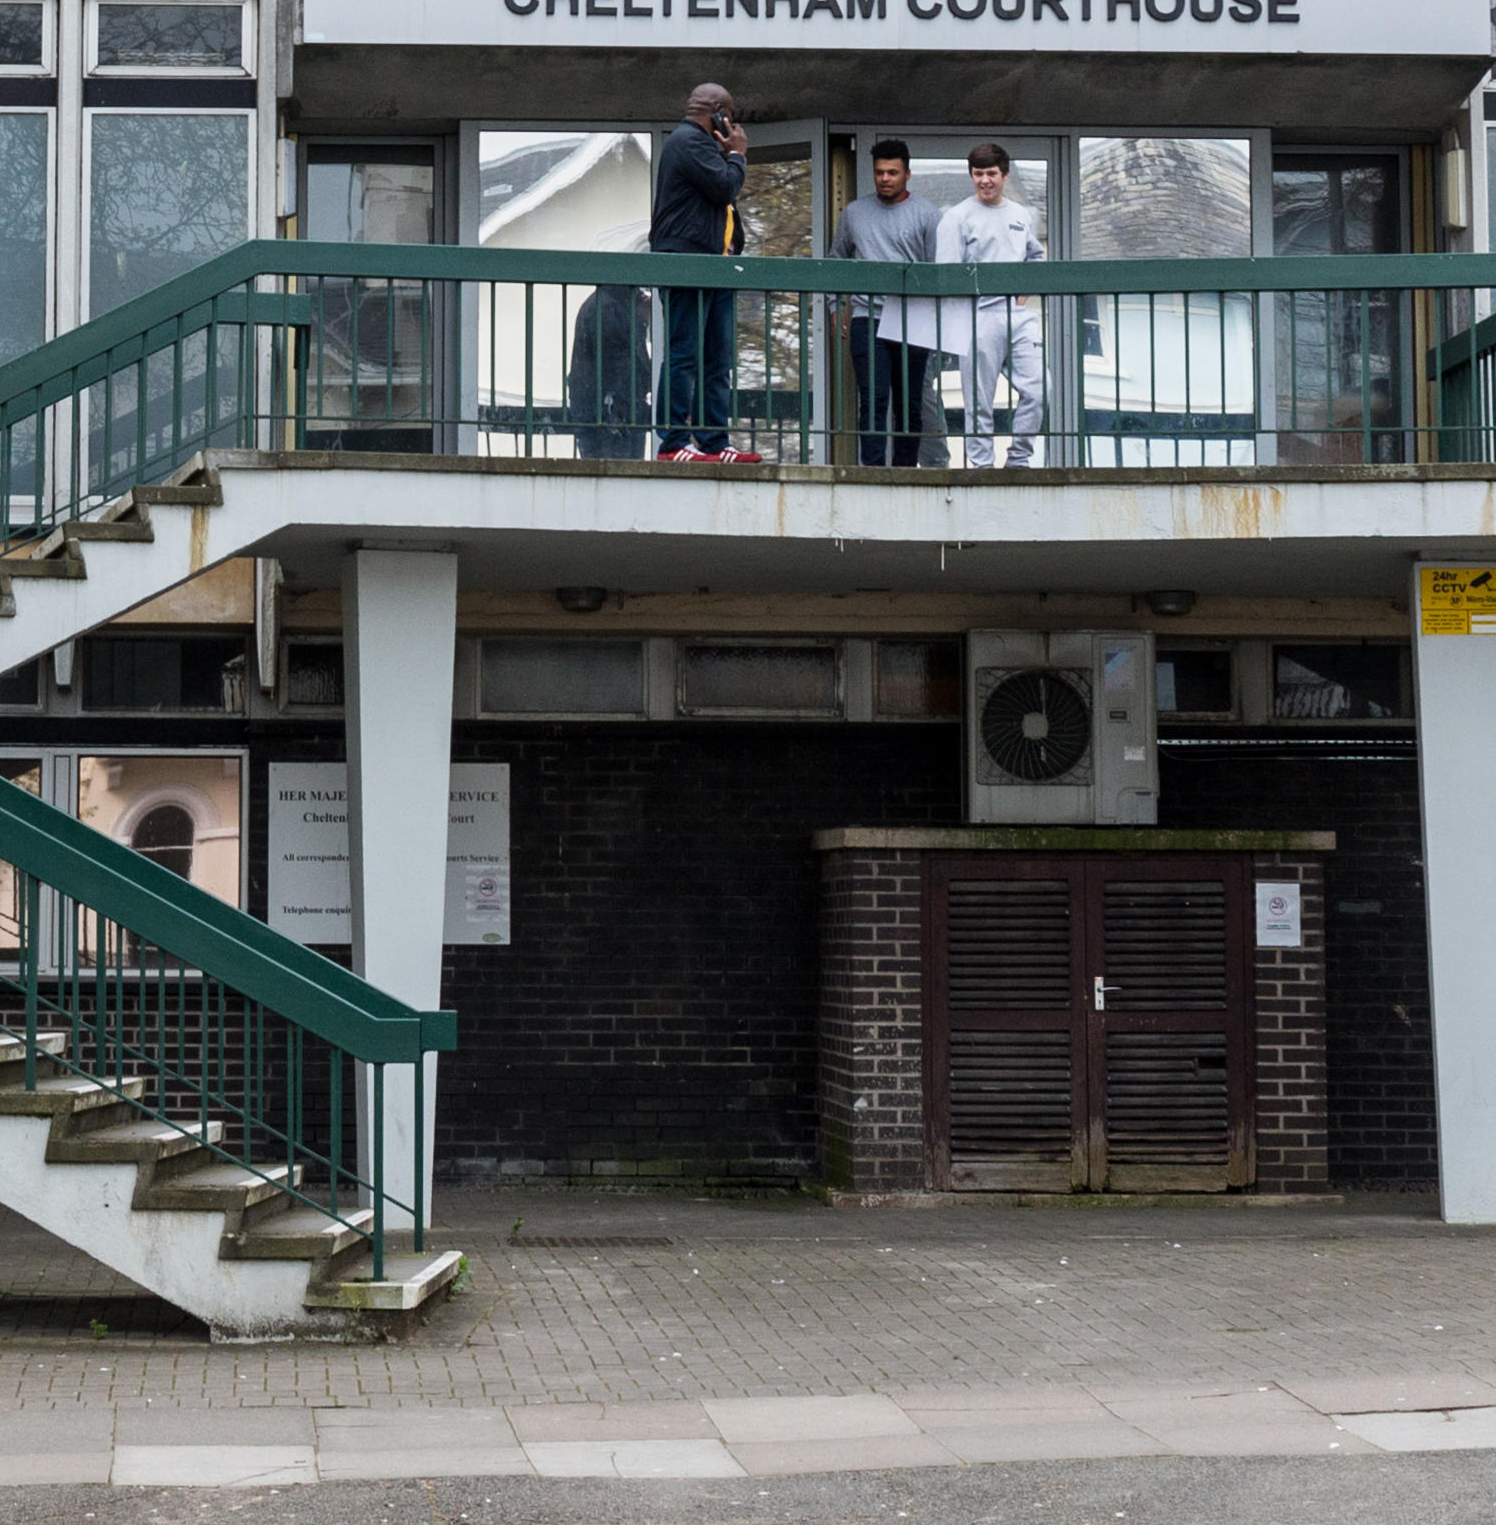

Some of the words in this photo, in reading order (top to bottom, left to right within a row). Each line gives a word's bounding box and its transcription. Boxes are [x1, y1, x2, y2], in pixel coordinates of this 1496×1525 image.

[1433, 571, 1458, 581] 24hr
[1432, 583, 1466, 594] CCTV
[279, 790, 306, 801] HER
[310, 790, 347, 802] MAJE
[449, 791, 499, 803] ERVICE
[283, 853, 295, 862] All
[283, 905, 323, 916] Telephone
